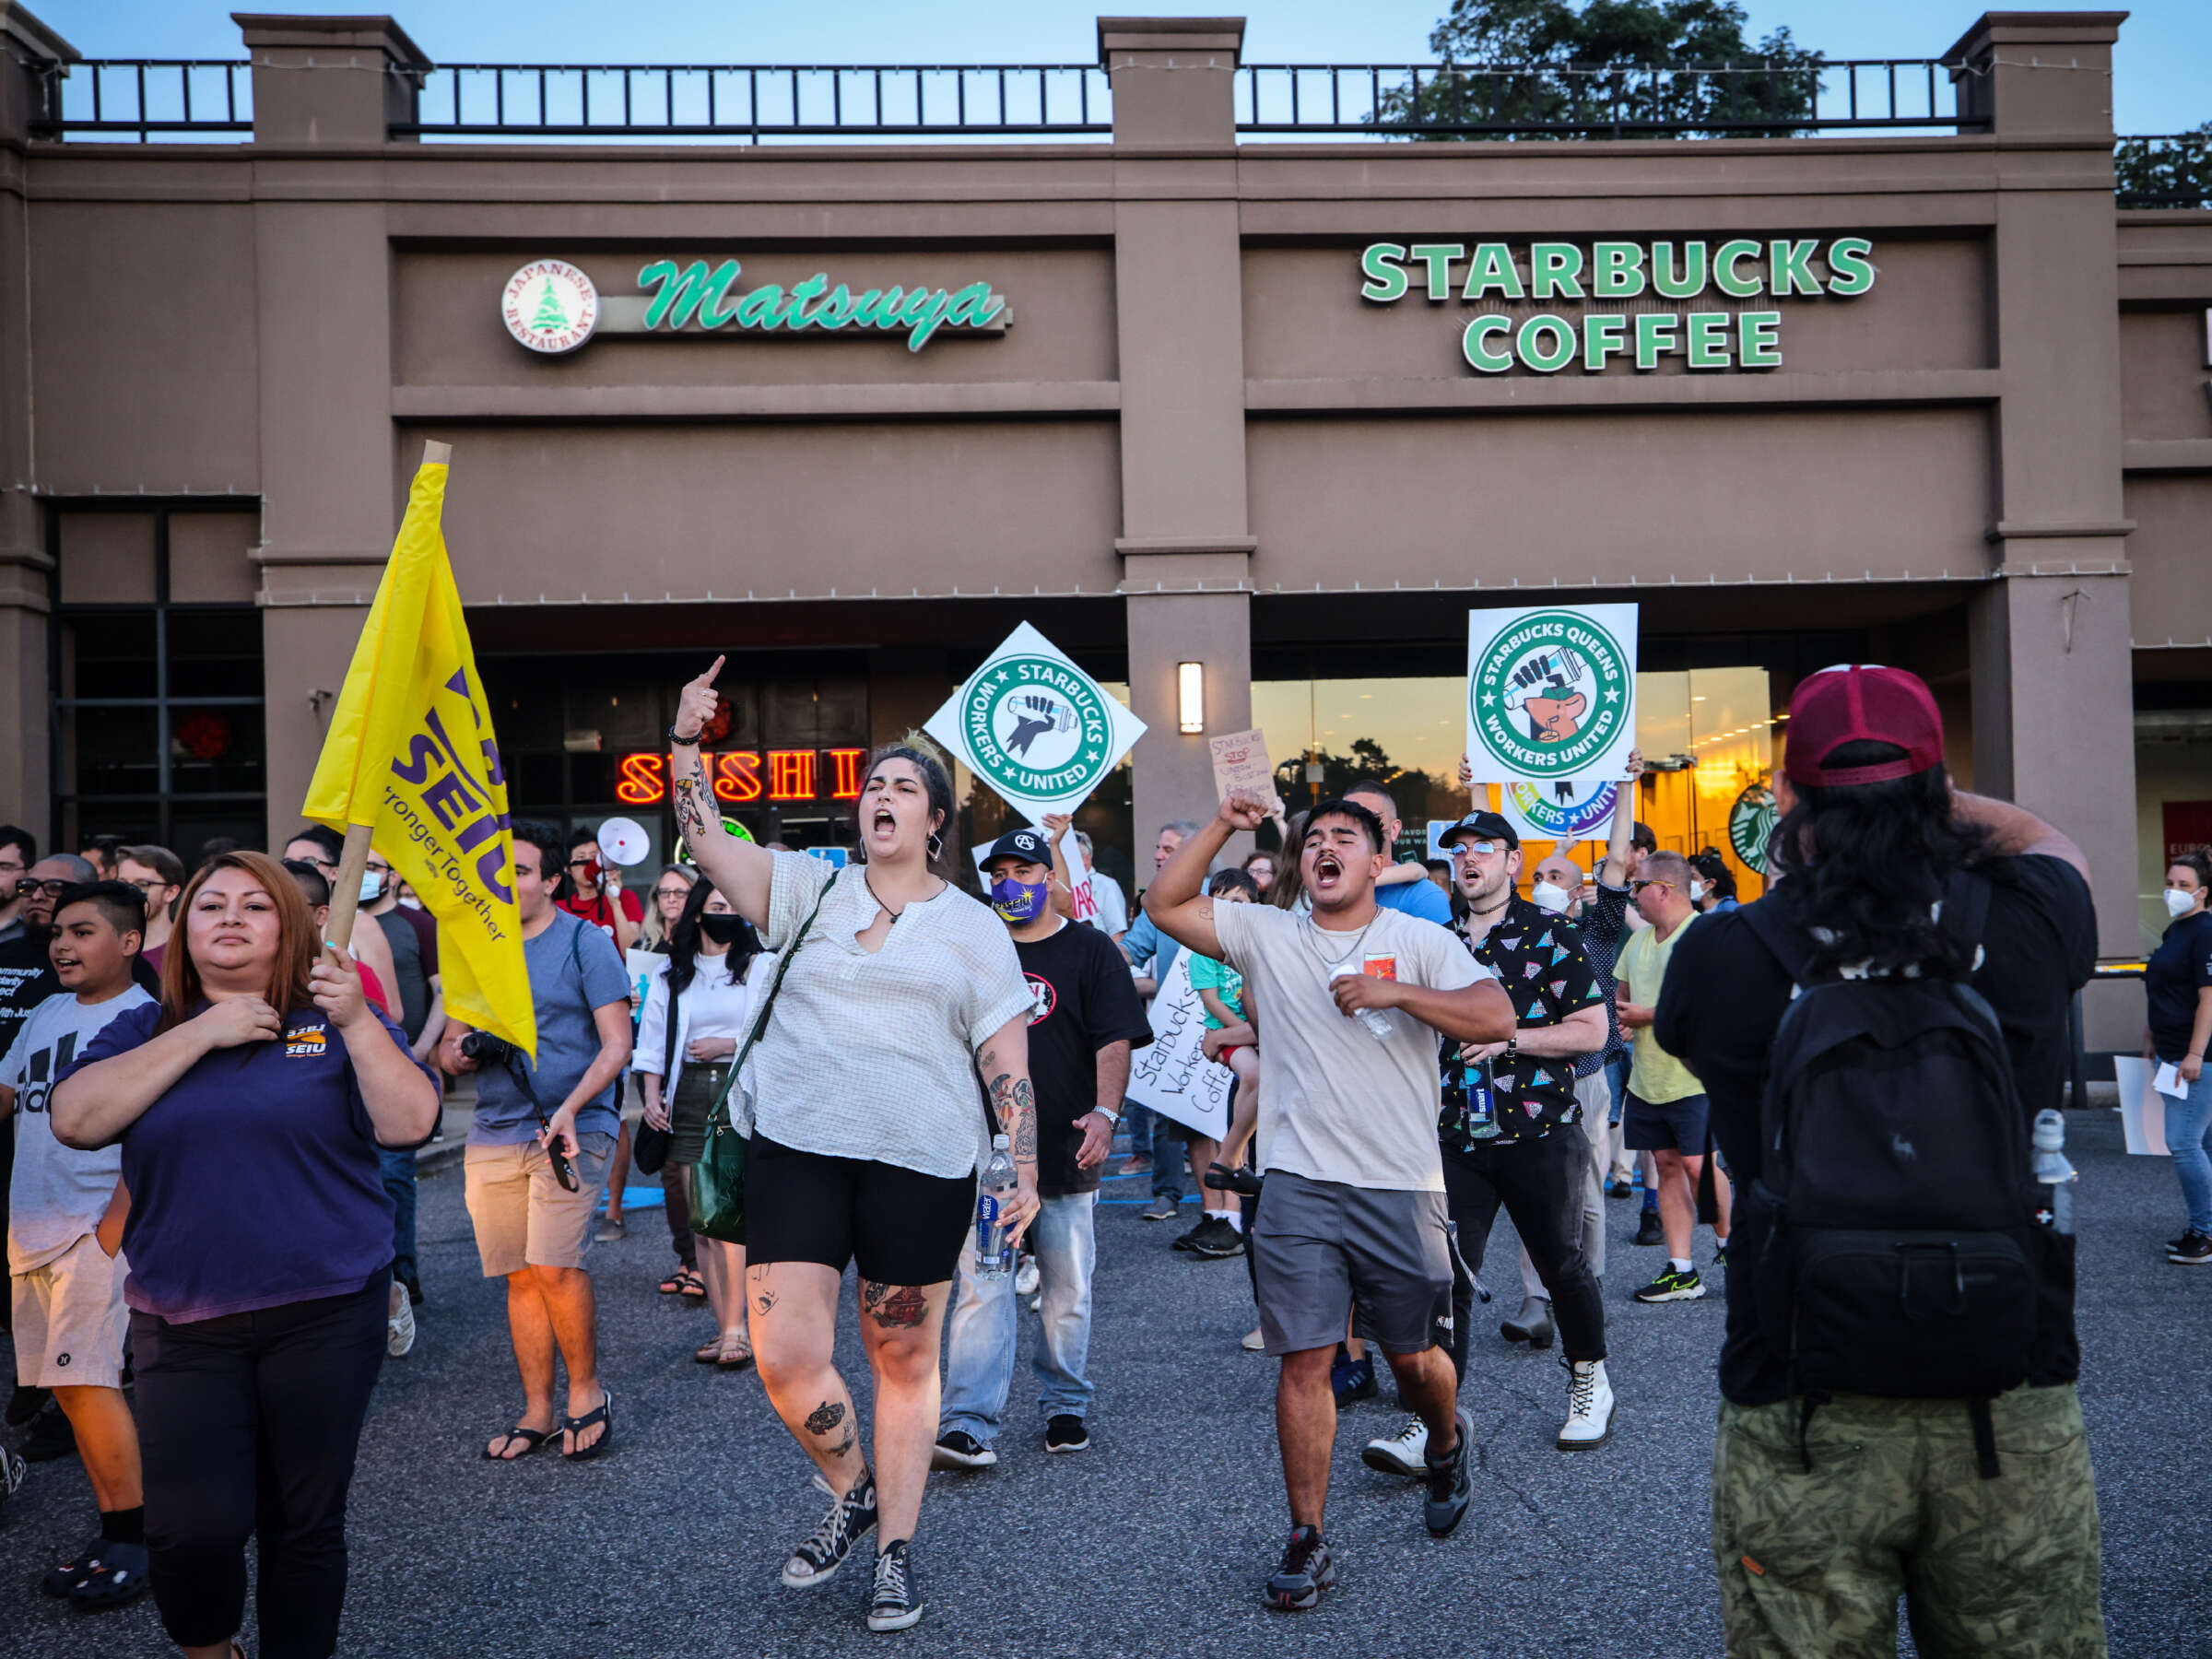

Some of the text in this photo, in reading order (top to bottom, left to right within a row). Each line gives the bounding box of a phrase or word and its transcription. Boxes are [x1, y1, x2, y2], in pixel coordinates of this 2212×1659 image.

[508, 263, 593, 301] JAPANESE
[1360, 238, 1877, 302] STARBUCKS
[506, 309, 593, 349] RESTAURANT
[637, 259, 1006, 353] Matsuya
[1463, 311, 1783, 372] COFFEE
[1483, 623, 1618, 687] STARBUCKS QUEENS
[971, 681, 1006, 769] WORKERS
[1018, 664, 1103, 745] STARBUCKS
[1485, 710, 1614, 767] WORKERS UNITED
[616, 749, 862, 805] SSHI
[1019, 763, 1088, 791] UNITED
[1515, 782, 1565, 825] ORKERS
[384, 786, 445, 856] ronger
[440, 853, 507, 941] Together
[286, 1043, 326, 1054] SEIU
[1476, 1088, 1487, 1113] smart
[982, 1195, 993, 1219] water
